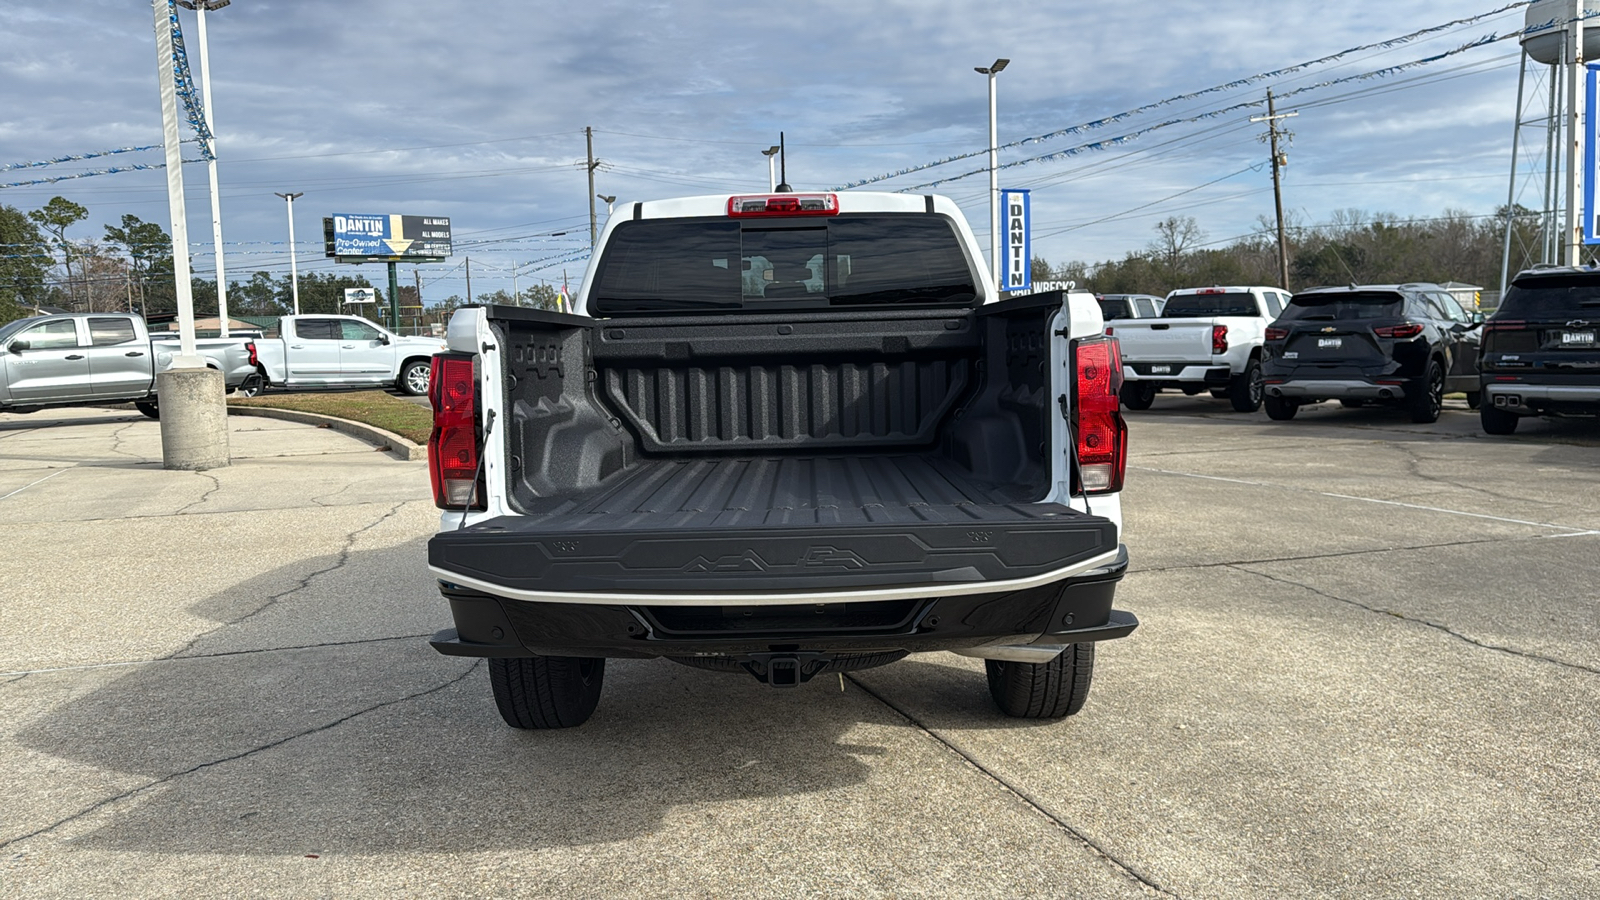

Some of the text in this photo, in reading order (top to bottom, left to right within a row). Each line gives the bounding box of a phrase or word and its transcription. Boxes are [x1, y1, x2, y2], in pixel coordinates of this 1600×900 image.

[334, 216, 383, 233] DANTIN
[336, 238, 381, 247] Pre-Owned
[1010, 204, 1023, 286] DANTIN
[336, 246, 364, 255] Center
[1562, 333, 1594, 343] DANTIN
